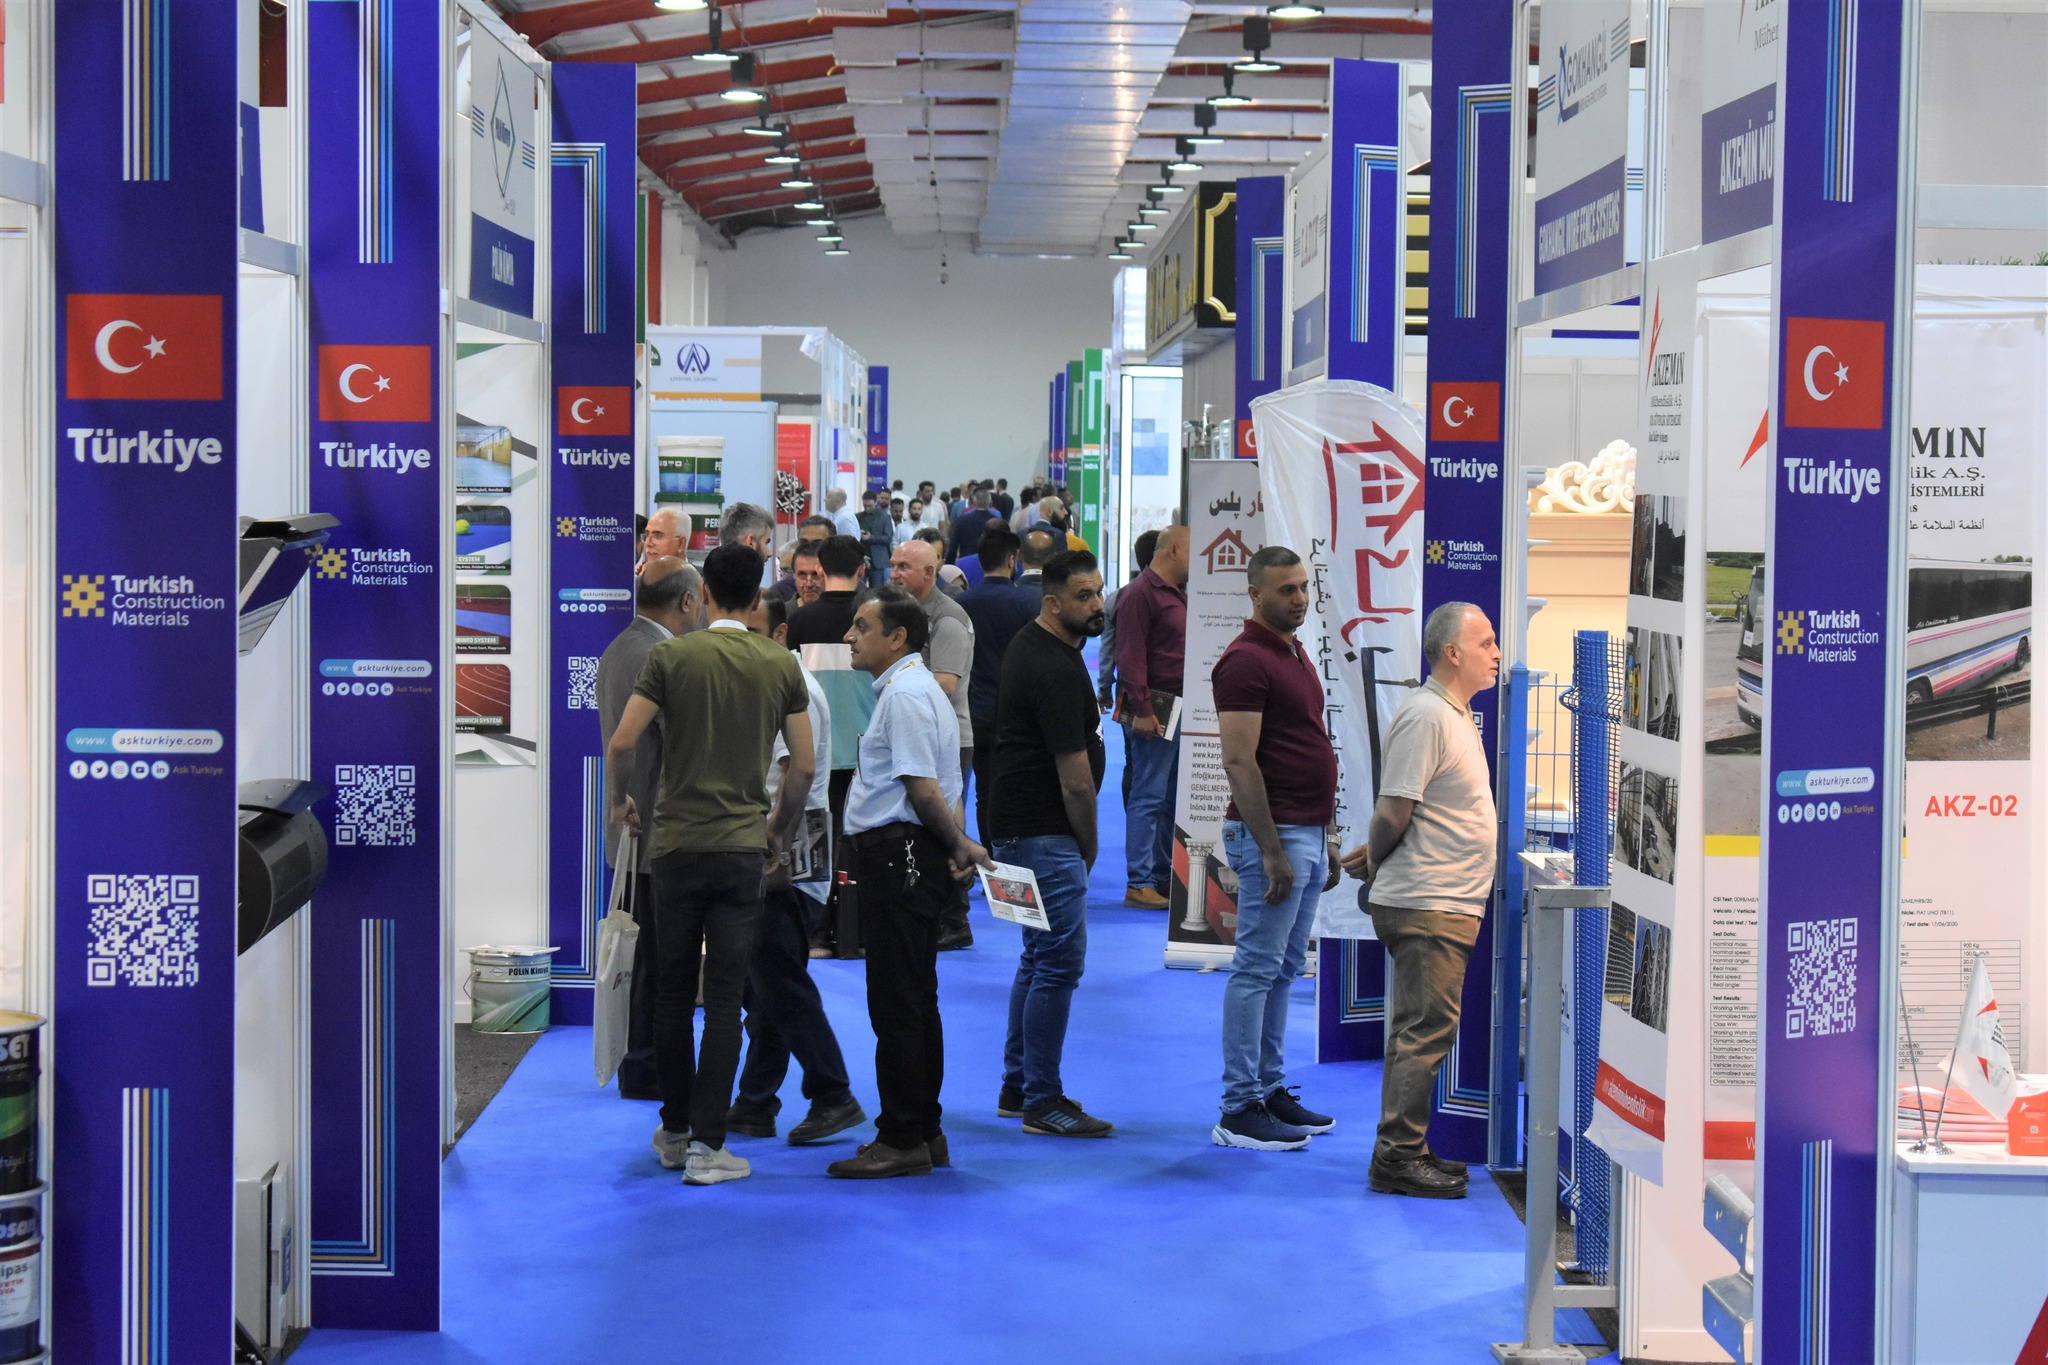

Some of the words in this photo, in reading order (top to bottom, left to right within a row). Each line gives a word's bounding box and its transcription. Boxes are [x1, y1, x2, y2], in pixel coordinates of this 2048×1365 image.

[1720, 119, 1758, 194] AKZEMİN
[67, 428, 222, 472] Türkiye
[319, 442, 431, 474] Türkiye
[558, 449, 631, 469] Türkiye
[1430, 457, 1498, 483] Türkiye
[1942, 466, 1985, 481] A.Ş.
[1784, 457, 1880, 503] Türkiye
[580, 516, 618, 526] Turkish
[1448, 540, 1484, 552] Turkish
[352, 548, 411, 562] Turkish
[1448, 552, 1497, 561] Construction
[352, 562, 433, 574] Construction
[1448, 561, 1482, 571] Materials
[111, 575, 194, 594] Turkish
[352, 574, 408, 586] Materials
[112, 594, 224, 610] Construction
[112, 611, 190, 626] Materials
[1808, 610, 1860, 629] Turkish
[1808, 630, 1879, 645] Construction
[1808, 648, 1856, 663] Materials
[357, 664, 426, 674] askturkiye.com
[120, 735, 213, 747] askturkiye.com
[1810, 776, 1868, 787] askturkiye.com
[1190, 793, 1212, 801] Karplus
[1924, 794, 2018, 817] AKZ-02
